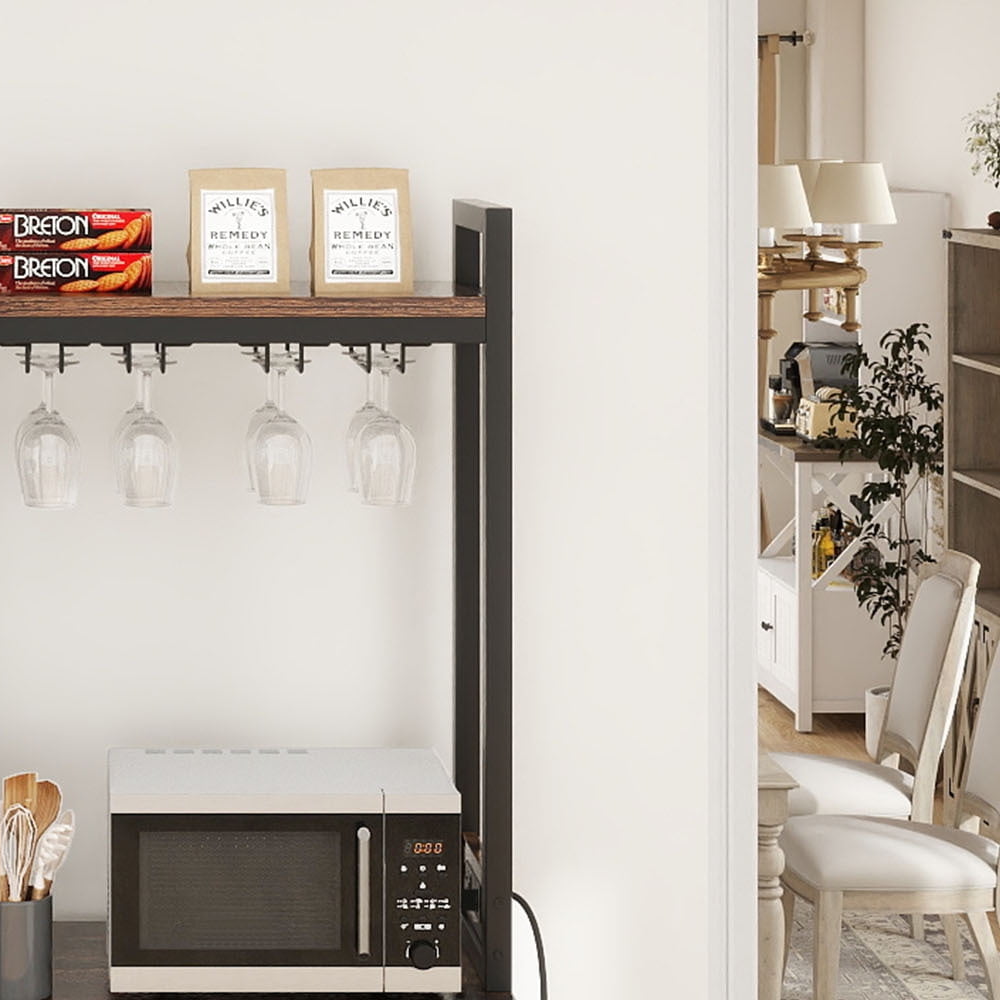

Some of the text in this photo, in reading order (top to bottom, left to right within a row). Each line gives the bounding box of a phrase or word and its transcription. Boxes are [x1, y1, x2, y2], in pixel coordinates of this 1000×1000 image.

[208, 197, 269, 217] WILLIE'S
[331, 197, 393, 217] WILLIE'S
[14, 214, 89, 237] BRETON
[210, 231, 268, 239] REMEDY
[334, 231, 392, 239] REMEDY
[14, 255, 89, 279] BRETON
